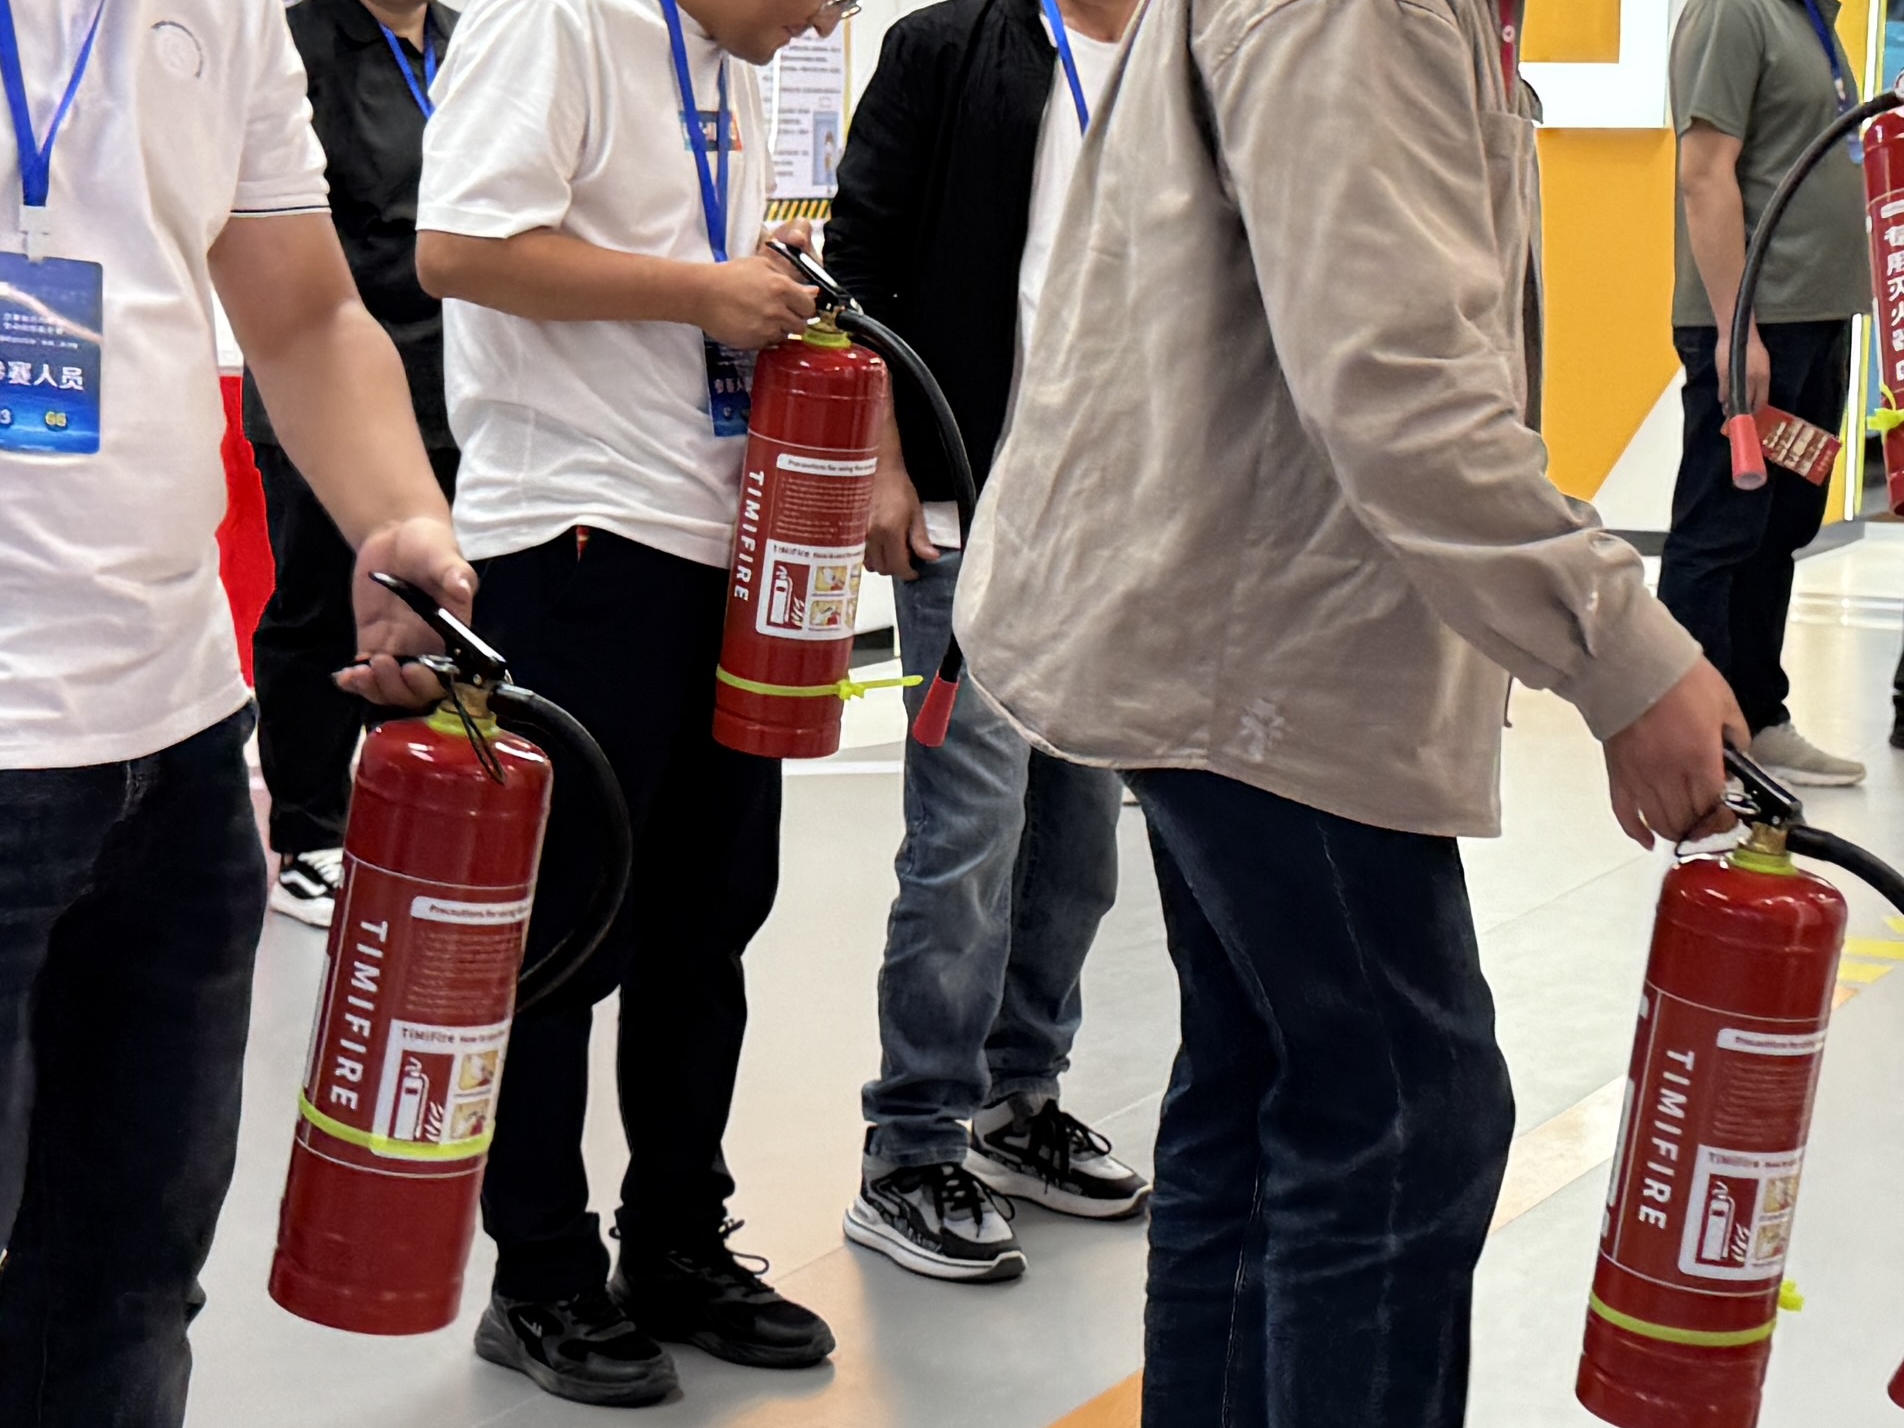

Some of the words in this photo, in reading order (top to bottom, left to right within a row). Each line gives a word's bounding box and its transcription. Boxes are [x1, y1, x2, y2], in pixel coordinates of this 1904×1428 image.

[734, 470, 765, 602] TIMIFIRE
[330, 920, 388, 1111] TIMIFIRE
[1638, 1049, 1695, 1230] TIMIFIRE
